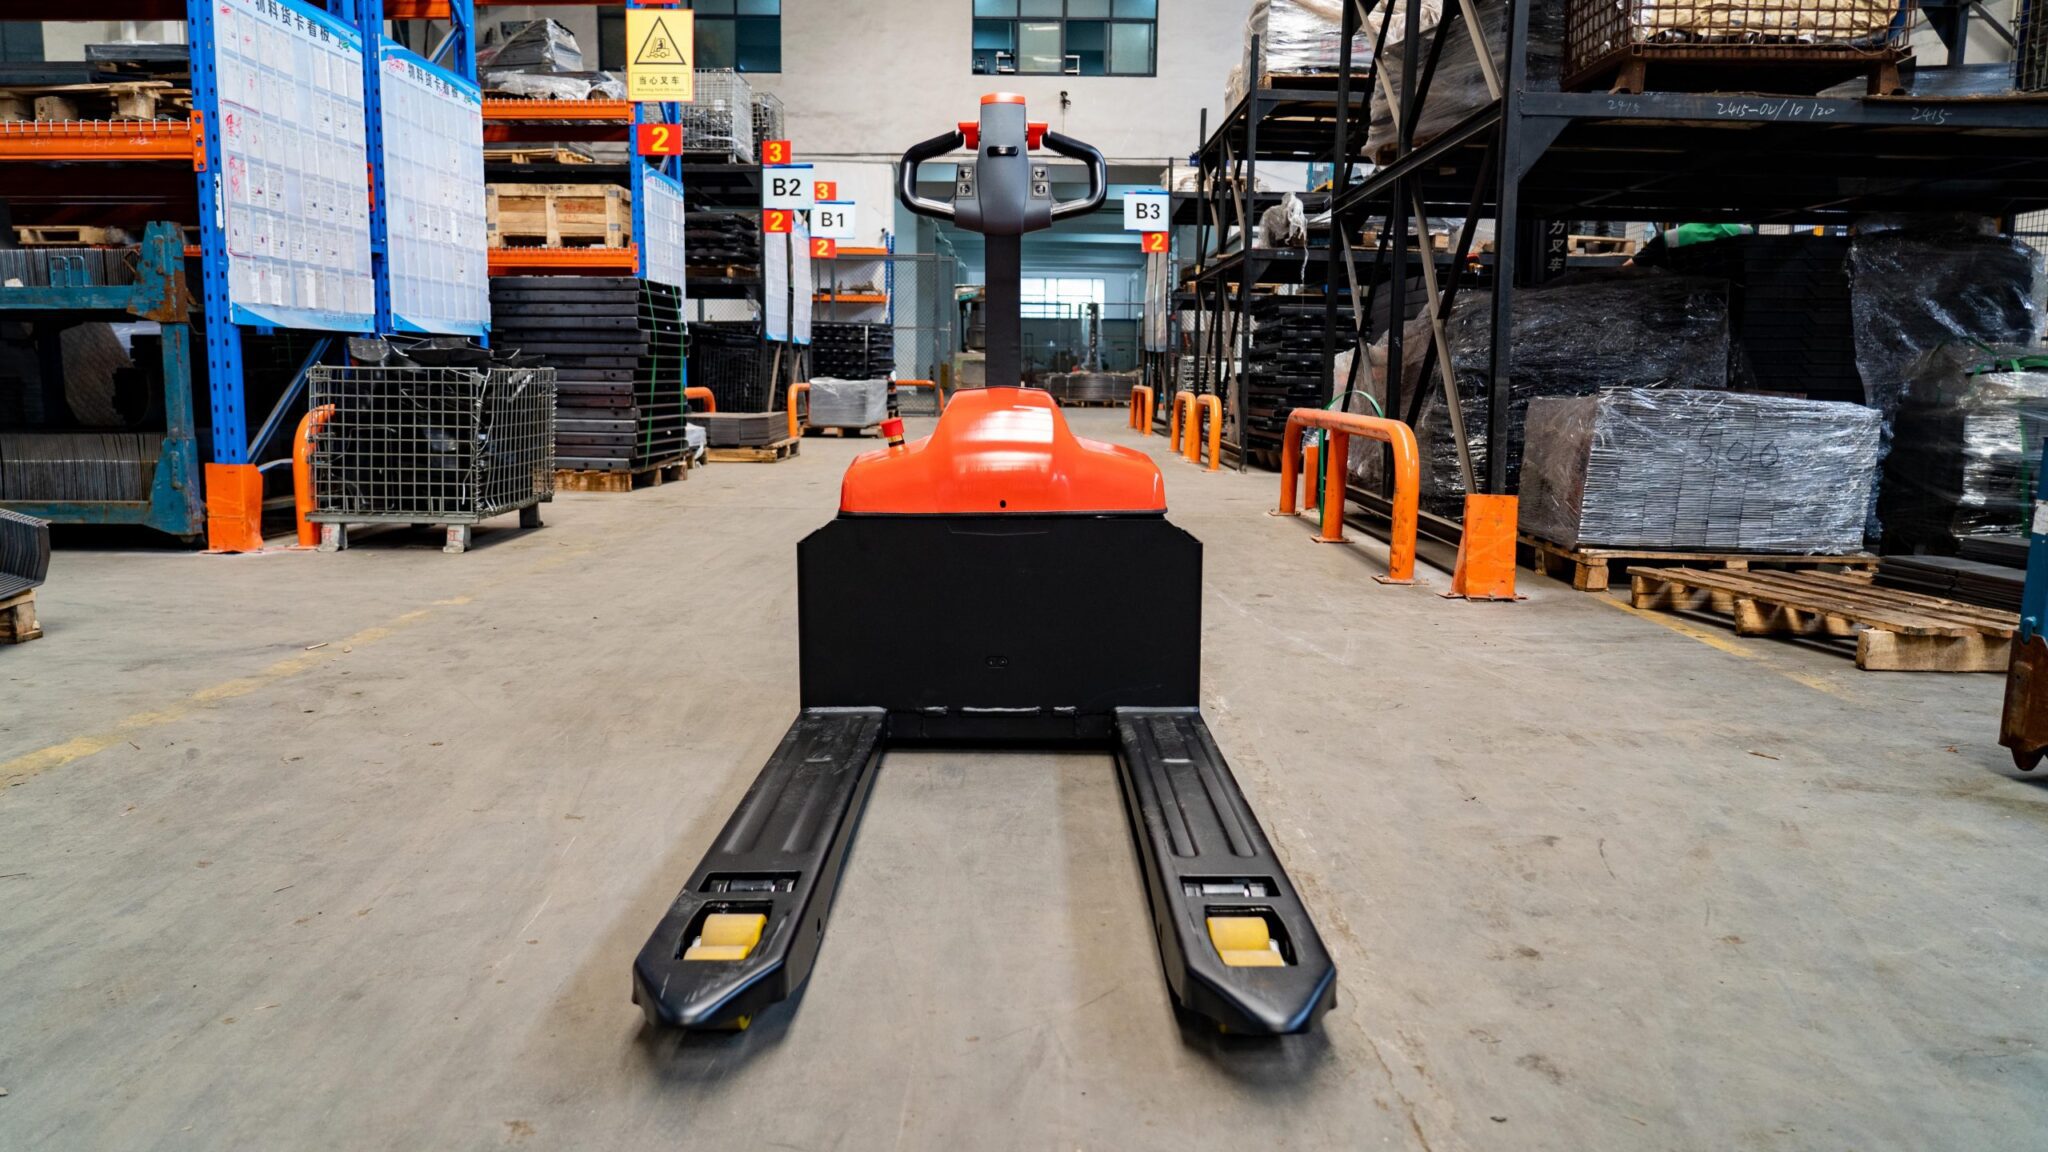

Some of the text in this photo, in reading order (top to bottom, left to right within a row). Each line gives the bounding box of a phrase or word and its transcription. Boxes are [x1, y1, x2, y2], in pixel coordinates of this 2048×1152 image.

[651, 126, 670, 152] 2
[769, 142, 782, 162] 3
[773, 178, 802, 197] B2
[817, 183, 829, 199] 3
[821, 212, 844, 228] B1
[1136, 202, 1160, 220] B3
[770, 211, 784, 231] 2
[816, 240, 829, 256] 2
[1151, 233, 1164, 251] 2
